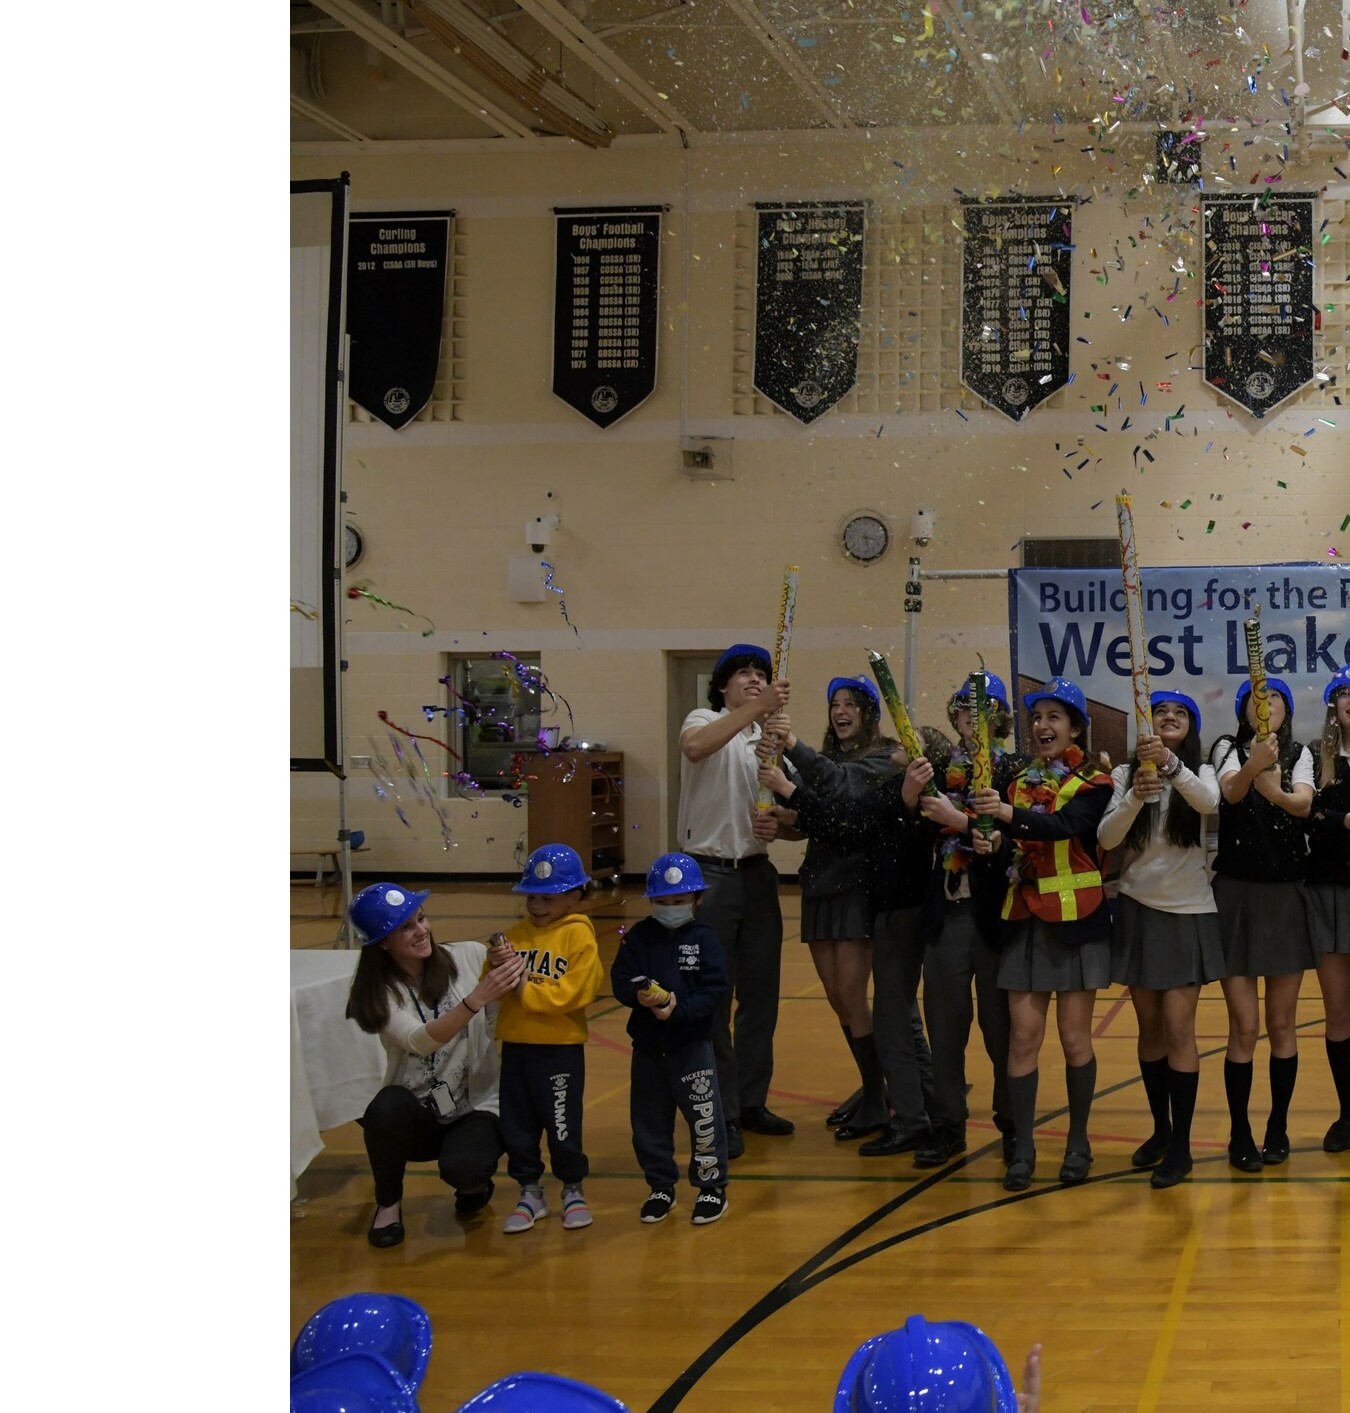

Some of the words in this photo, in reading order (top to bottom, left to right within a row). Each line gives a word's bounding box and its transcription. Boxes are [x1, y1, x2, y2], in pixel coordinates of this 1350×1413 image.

[379, 228, 417, 241] Curling
[572, 224, 600, 236] Boys'
[603, 223, 644, 235] Football
[1229, 224, 1288, 235] Champons
[370, 242, 426, 255] Champions
[579, 237, 636, 250] Champions
[357, 261, 376, 270] 2012
[1275, 284, 1290, 293] (SR)
[1275, 326, 1291, 335] (SR)
[1040, 581, 1194, 619] Builng
[1205, 578, 1256, 611] for
[1267, 577, 1328, 610] the
[1039, 622, 1203, 676] West
[514, 949, 569, 981] MAS
[554, 1090, 569, 1142] PUMAS
[693, 1101, 720, 1182] PUMAS
